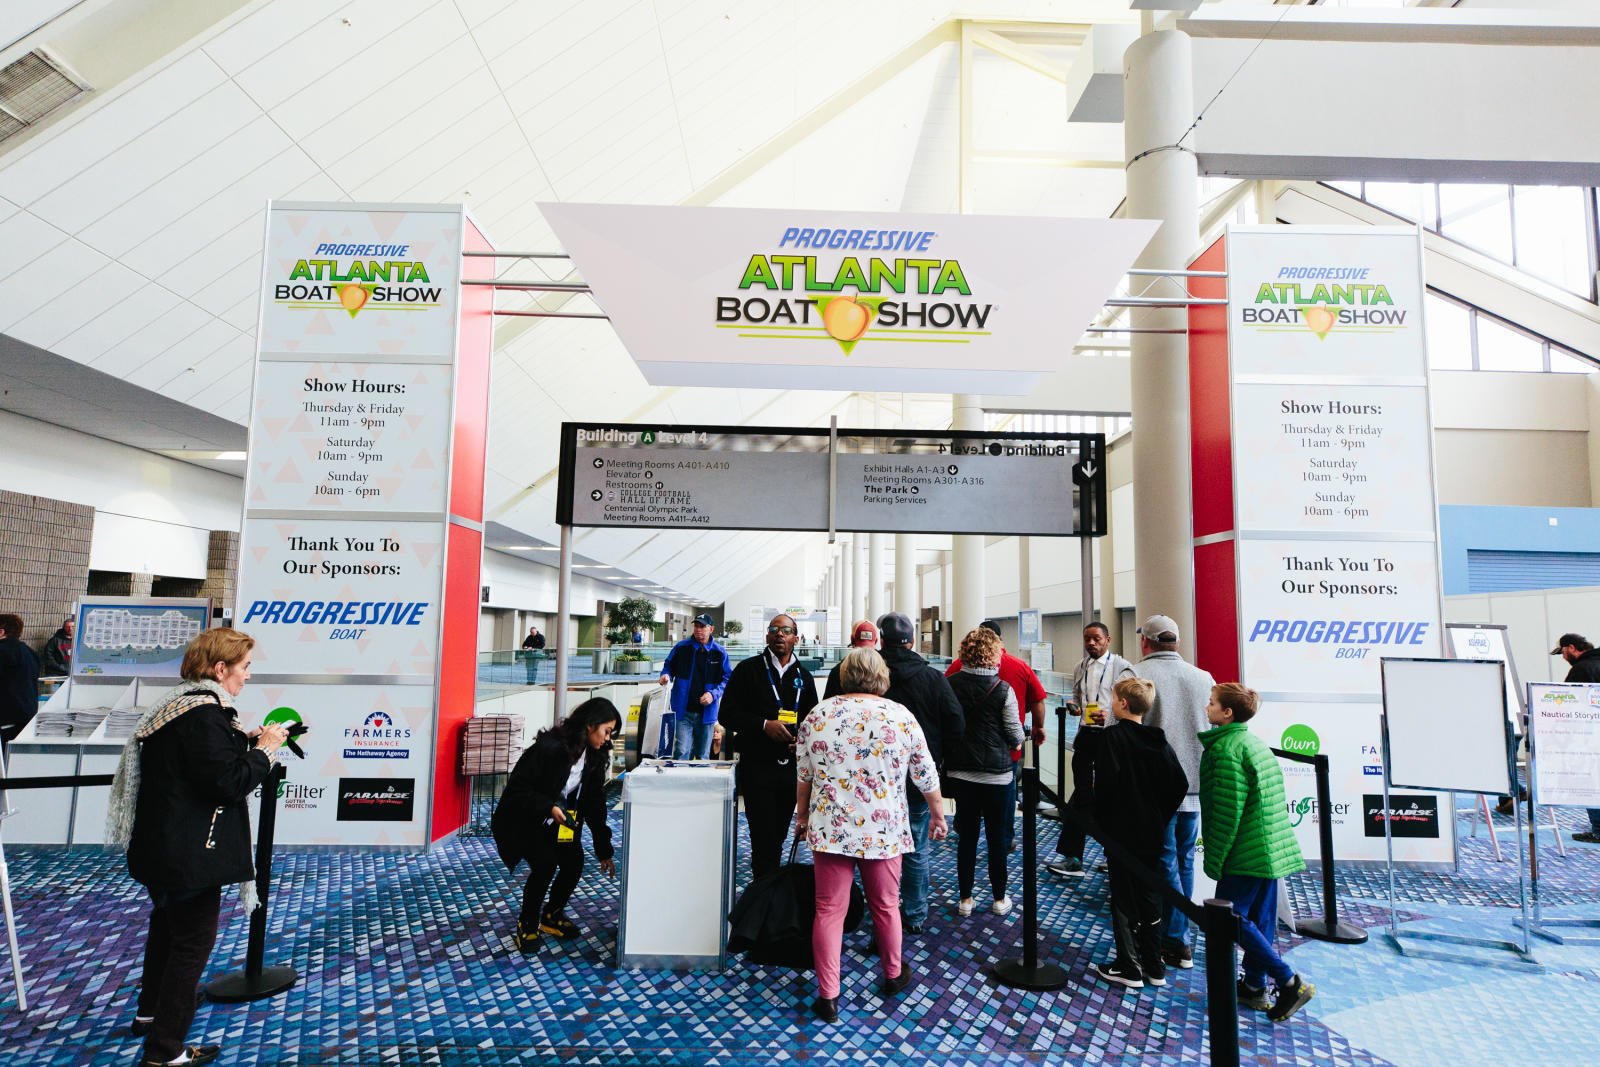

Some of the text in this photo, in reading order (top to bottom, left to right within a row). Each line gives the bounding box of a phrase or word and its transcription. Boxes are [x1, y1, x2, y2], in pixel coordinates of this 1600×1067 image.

[778, 227, 935, 251] PROGRESSIVE
[315, 243, 410, 258] PROGRESSIVE
[289, 259, 431, 283] ATLANTA
[738, 254, 972, 296] ATLANTA
[1277, 267, 1370, 280] PROGRESSIVE
[274, 284, 442, 302] BOAT SHOW
[1255, 282, 1395, 306] ATLANTA
[715, 296, 993, 329] BOAT SHOW
[1242, 308, 1407, 325] BOAT SHOW
[303, 377, 406, 394] Show Hours:
[302, 401, 405, 418] Thursday & Friday
[1281, 400, 1382, 416] Show Hours:
[320, 416, 350, 427] 11am
[360, 417, 386, 430] 9pm
[576, 428, 637, 446] Building
[658, 430, 696, 444] Level
[698, 432, 708, 444] 4
[1281, 423, 1383, 438] Thursday & Friday
[327, 436, 376, 450] Saturday
[1300, 438, 1330, 448] 11am
[1340, 438, 1366, 450] 9pm
[318, 450, 348, 461] 10am
[358, 451, 384, 464] 9pm
[606, 460, 730, 470] Meeting Rooms A401-A410
[863, 464, 945, 474] Exhibit Halls A1-A3
[1309, 458, 1358, 471] Saturday
[328, 471, 369, 484] Sunday
[606, 470, 641, 479] Elevator
[863, 476, 984, 486] Meeting Rooms A301-A316
[1302, 472, 1332, 482] 10am
[1342, 472, 1368, 484] 9pm
[606, 480, 653, 489] Restrooms
[864, 486, 908, 494] The Park
[314, 485, 345, 496] 10am
[354, 486, 381, 499] 6pm
[654, 490, 691, 498] FOOTBALL
[1314, 492, 1356, 505] Sunday
[620, 496, 646, 504] HALL
[863, 495, 927, 504] Parking Services
[604, 504, 698, 514] Centennial Olympic Park
[1304, 506, 1334, 516] 10am
[1344, 506, 1370, 519] 6pm
[604, 514, 636, 522] Meeting
[639, 514, 666, 522] Rooms
[287, 536, 400, 552] Thank You To
[282, 560, 401, 579] Our Sponsors:
[1282, 556, 1394, 572] Thank You To
[1281, 579, 1398, 598] Our Sponsors:
[243, 600, 428, 625] PROGRESSIVE
[328, 628, 366, 640] BOAT
[1249, 619, 1430, 645] PROGRESSIVE
[1334, 648, 1370, 659] BOAT
[1574, 712, 1600, 720] Storyti
[344, 728, 411, 738] FARMERS
[1283, 736, 1318, 750] Own
[386, 750, 408, 758] Agency
